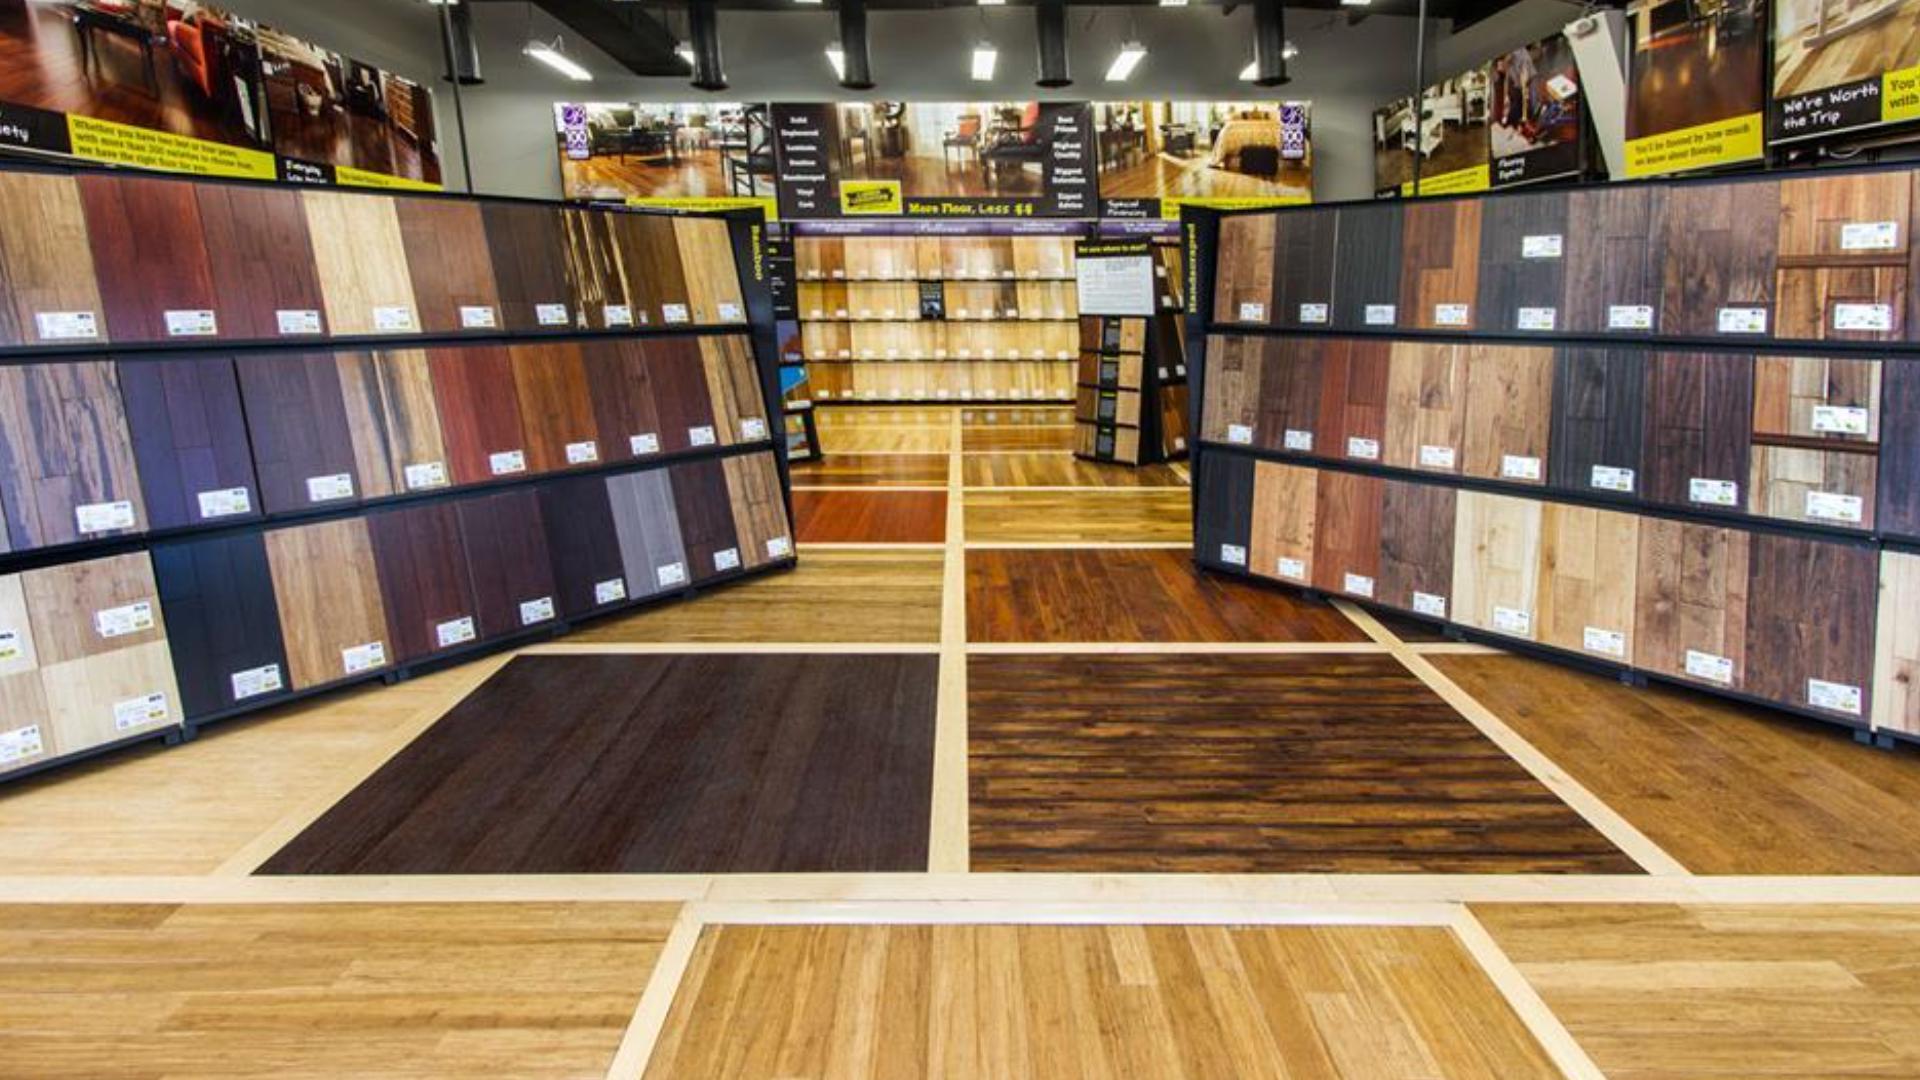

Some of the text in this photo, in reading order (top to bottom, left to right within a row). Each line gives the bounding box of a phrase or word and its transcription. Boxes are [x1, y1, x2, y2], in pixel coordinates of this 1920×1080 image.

[1783, 84, 1879, 113] We're Worth
[1783, 110, 1841, 130] the Trip
[909, 203, 939, 213] More
[979, 203, 1009, 214] Less
[751, 225, 763, 281] Bamboo
